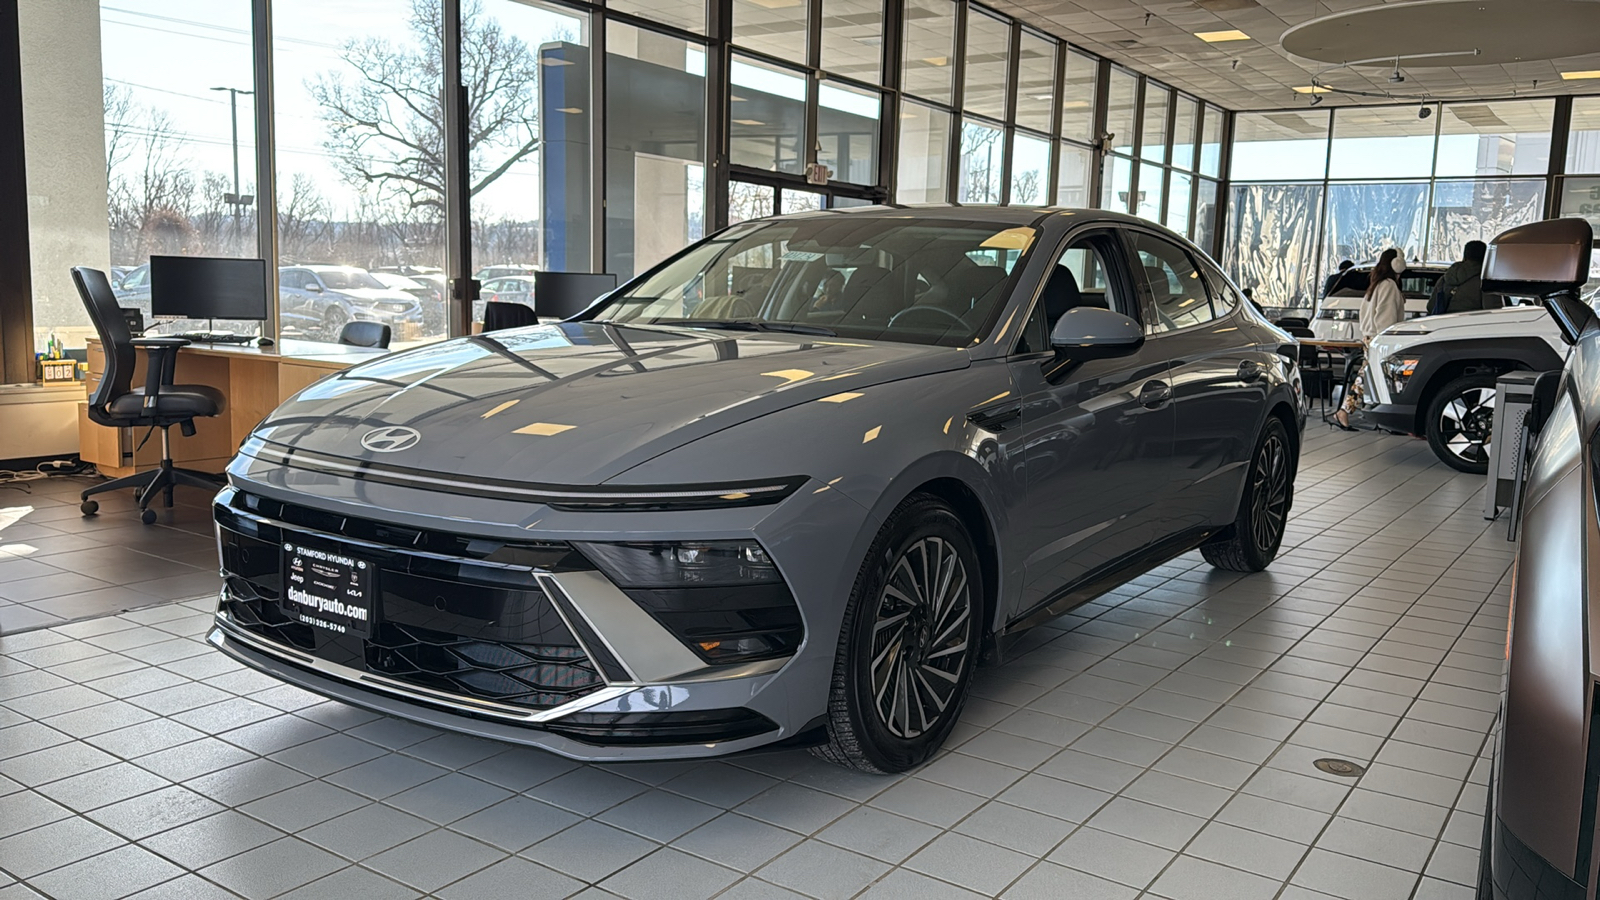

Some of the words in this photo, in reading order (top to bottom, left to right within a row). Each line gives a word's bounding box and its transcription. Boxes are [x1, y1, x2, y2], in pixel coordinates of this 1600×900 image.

[296, 547, 327, 560] STAMFORD
[327, 554, 355, 567] HYUNDAI
[290, 572, 304, 584] Jeep
[288, 585, 368, 621] danburyauto.com
